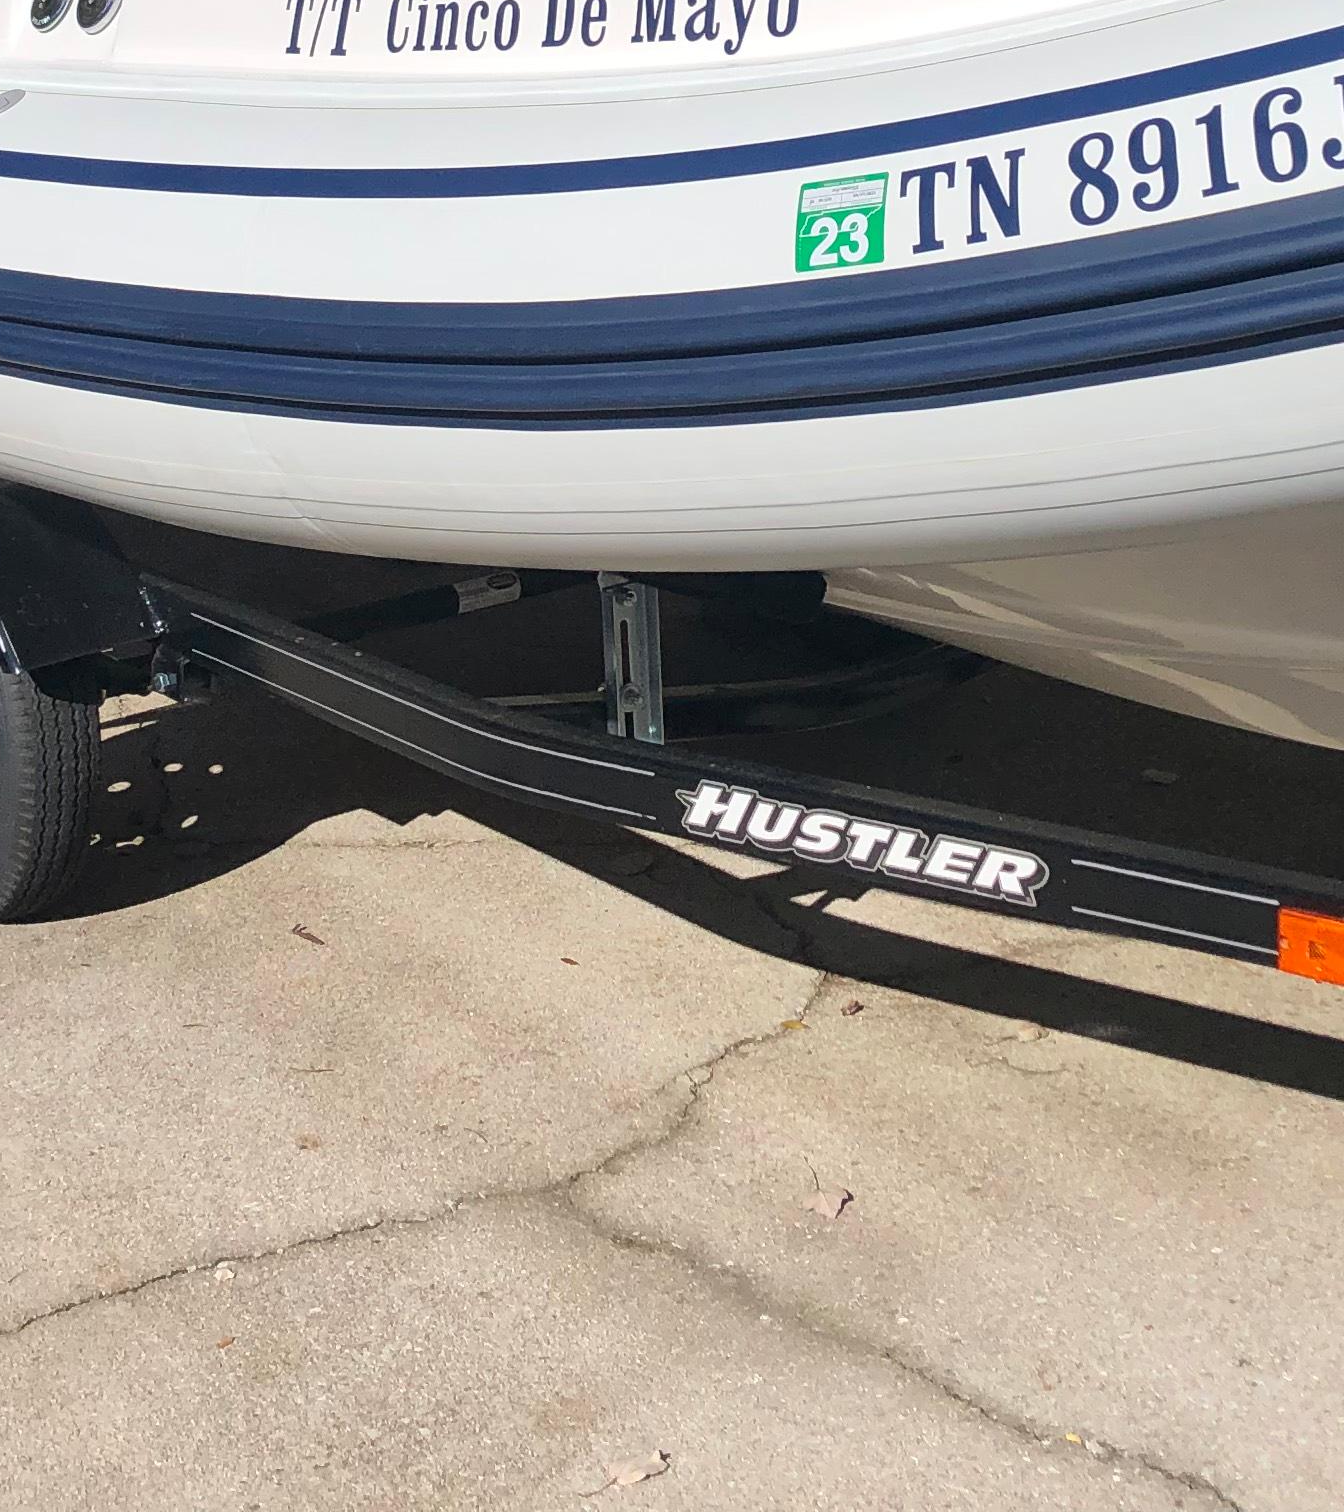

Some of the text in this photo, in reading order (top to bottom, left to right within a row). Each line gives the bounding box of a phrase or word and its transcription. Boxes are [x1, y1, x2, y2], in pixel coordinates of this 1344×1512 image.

[809, 212, 870, 267] 23
[899, 147, 1026, 255] TN
[680, 782, 1046, 903] HUSTLER
